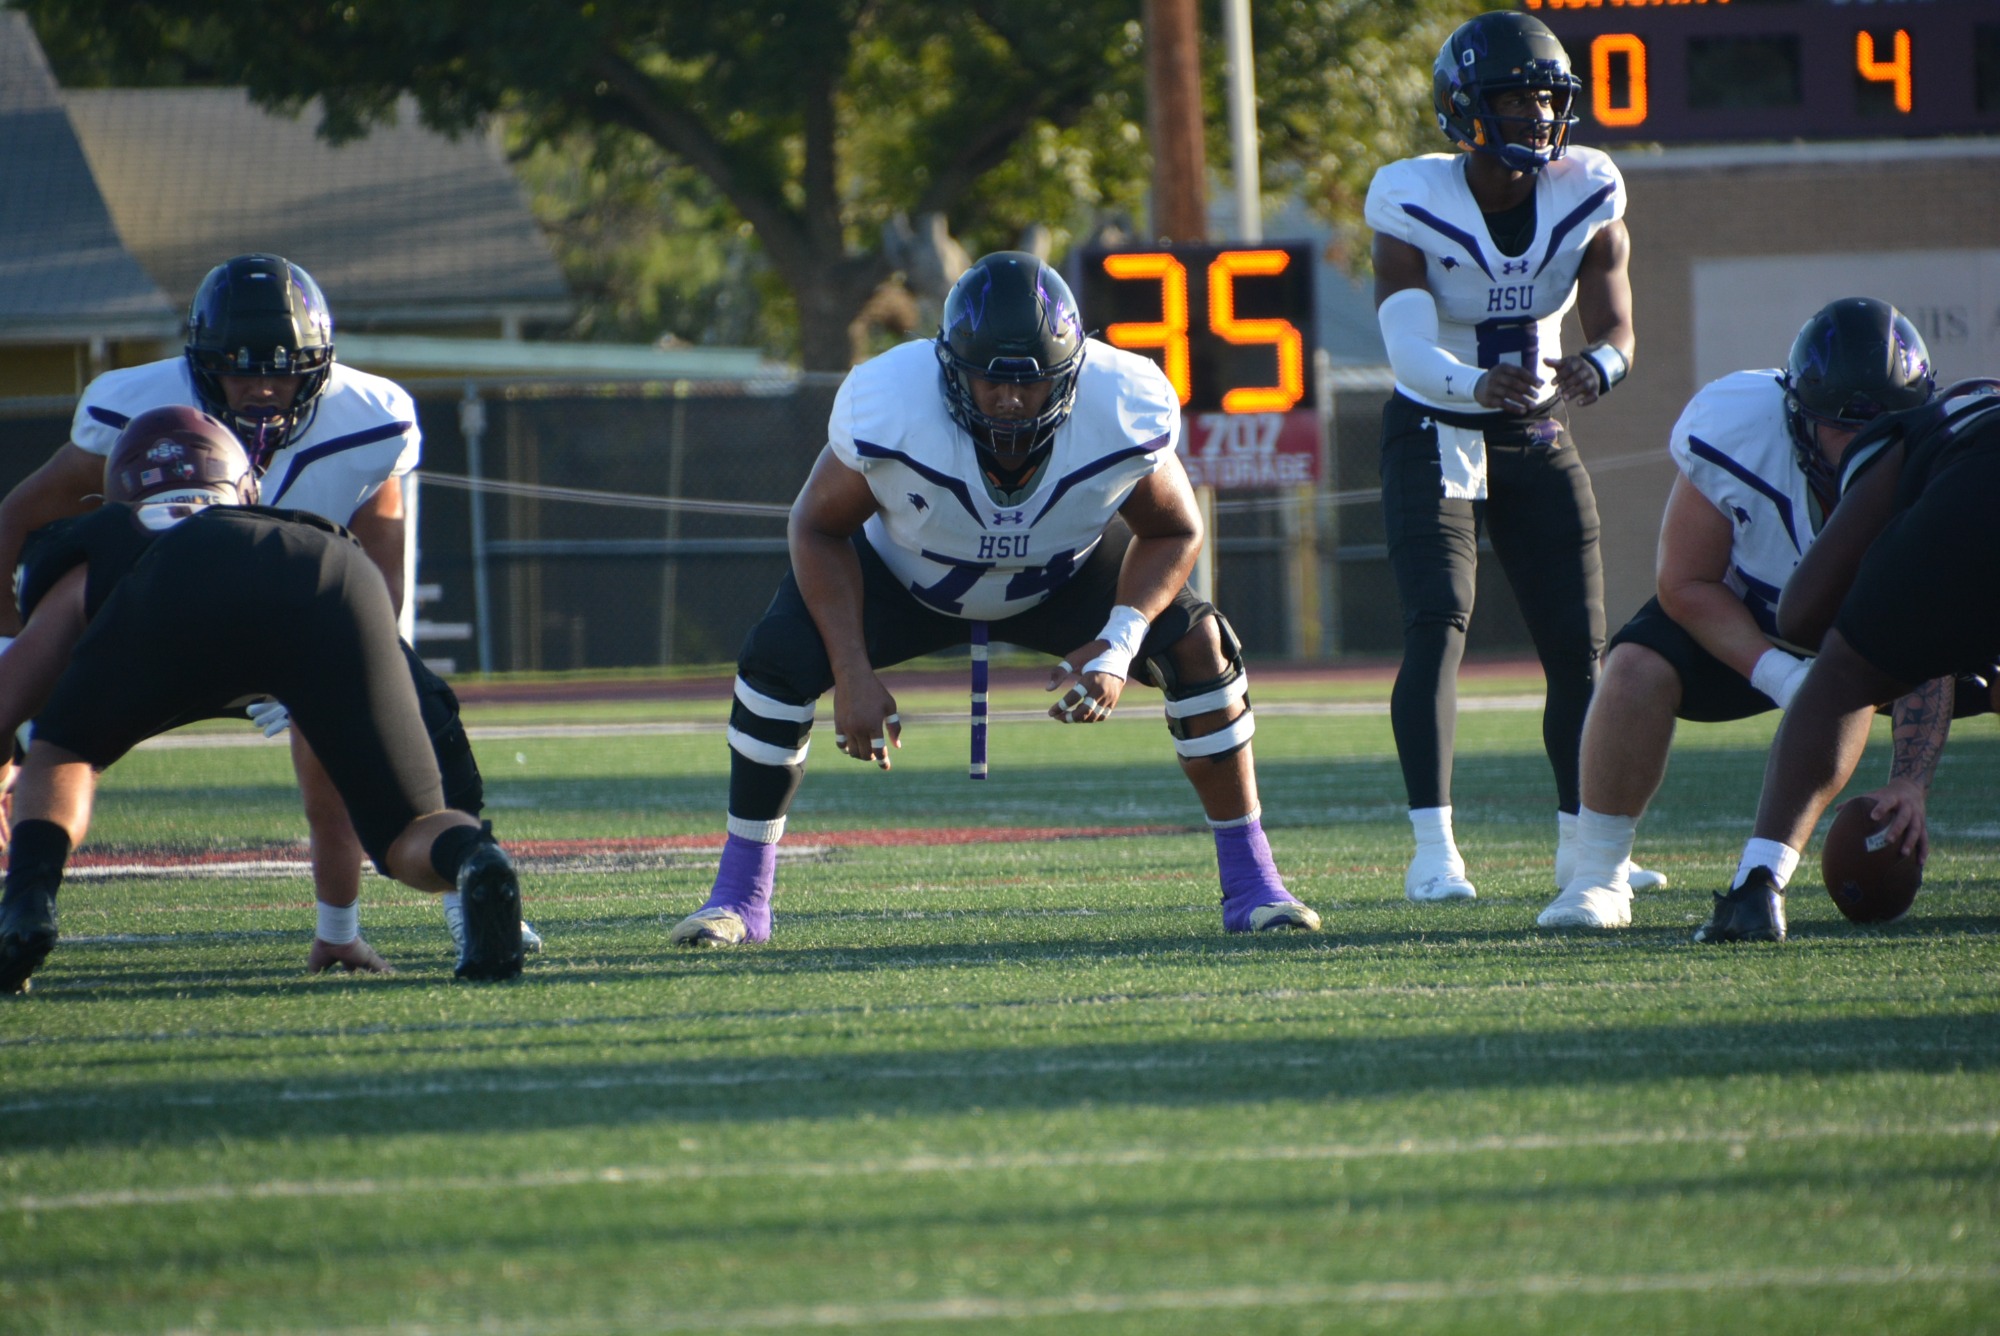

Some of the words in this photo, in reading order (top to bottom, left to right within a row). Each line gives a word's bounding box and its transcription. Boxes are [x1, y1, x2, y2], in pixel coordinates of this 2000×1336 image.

[1590, 33, 1648, 128] 0
[1856, 28, 1912, 114] 4
[1486, 284, 1535, 312] HSU
[1103, 249, 1304, 414] 35
[1198, 411, 1284, 455] 707
[976, 534, 1031, 559] HSU
